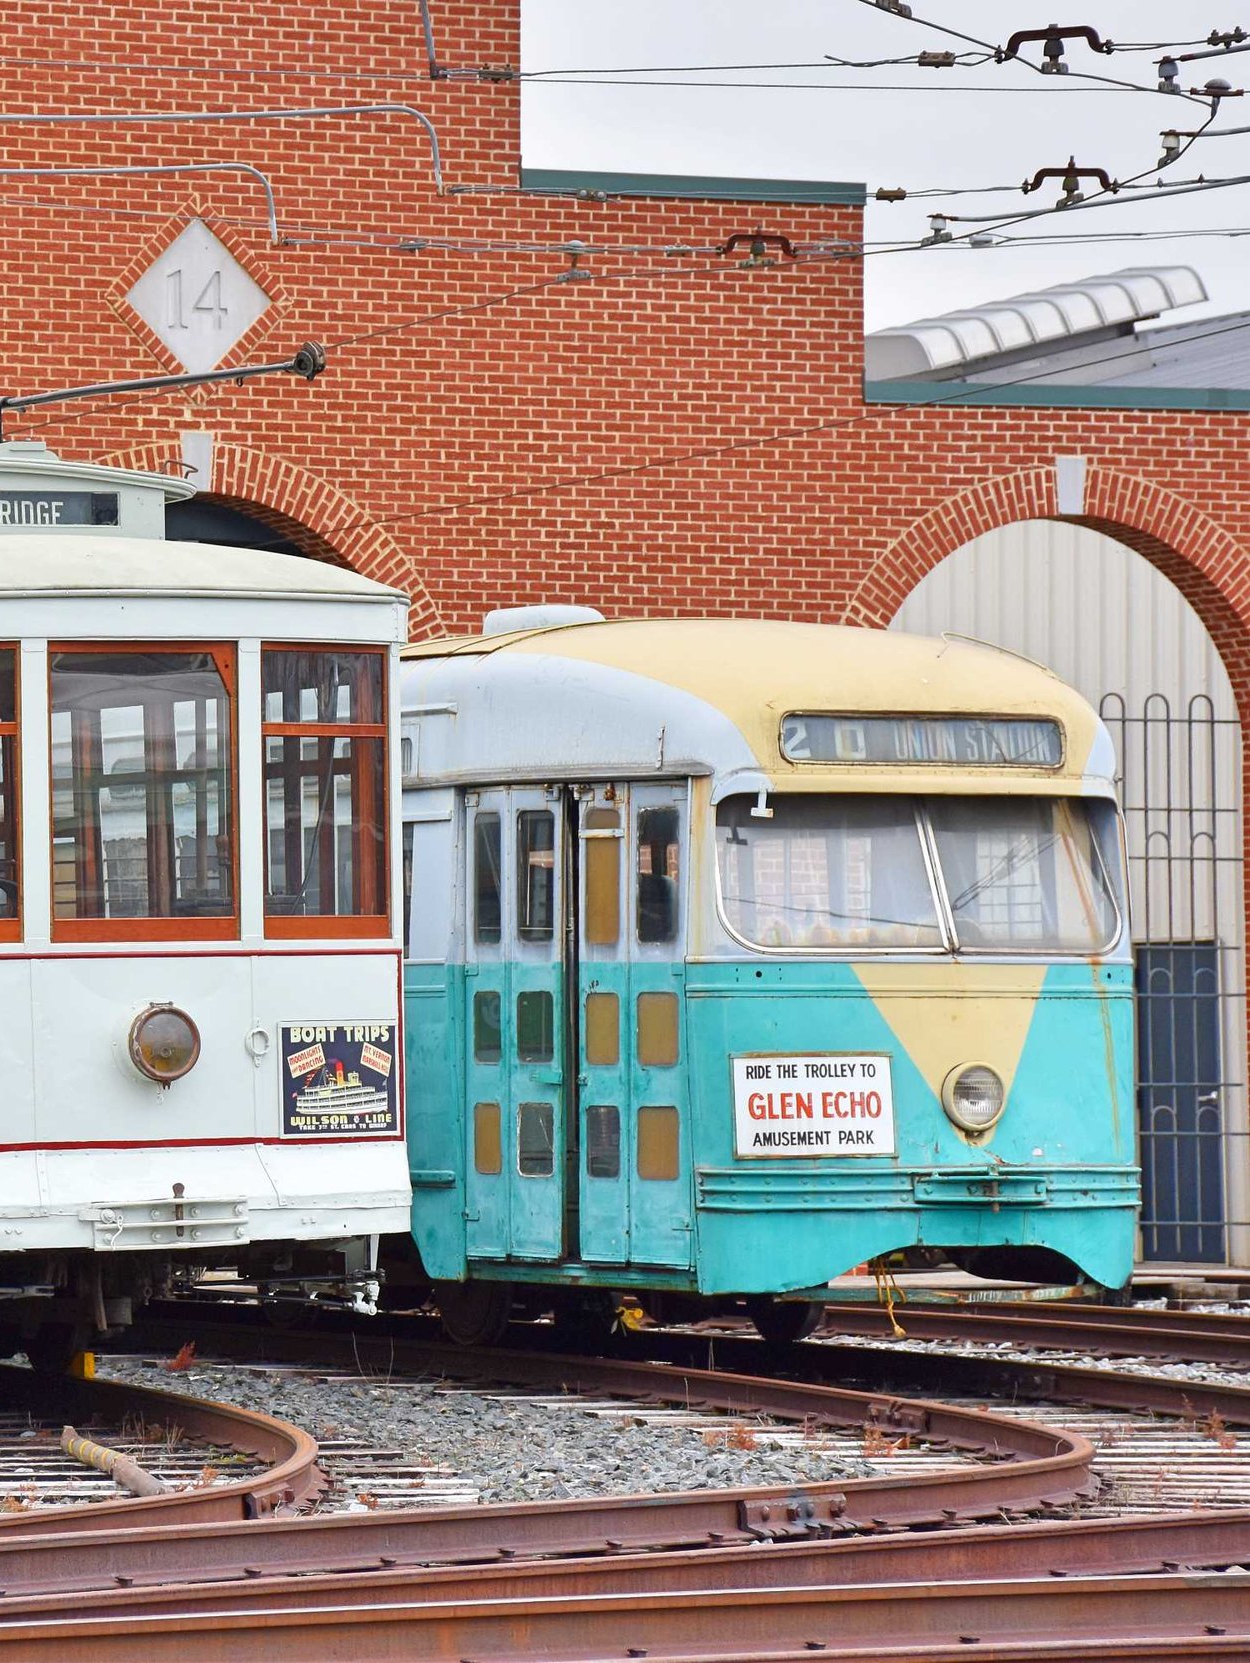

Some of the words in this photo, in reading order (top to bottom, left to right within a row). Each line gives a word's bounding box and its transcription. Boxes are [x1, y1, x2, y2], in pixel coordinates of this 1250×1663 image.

[166, 269, 228, 330] 14
[895, 720, 956, 761] UNION
[290, 1026, 337, 1043] BOAT
[344, 1026, 390, 1042] TRIPS
[746, 1065, 772, 1079] RIDE
[777, 1064, 798, 1079] THE
[804, 1063, 856, 1078] TROLLEY
[860, 1063, 876, 1077] TO
[748, 1092, 814, 1120] GLEN
[821, 1091, 882, 1119] ECHO
[291, 1115, 347, 1126] WILSON
[365, 1112, 392, 1123] LINE
[753, 1131, 831, 1147] AMUSEMENT
[838, 1130, 875, 1145] PARK
